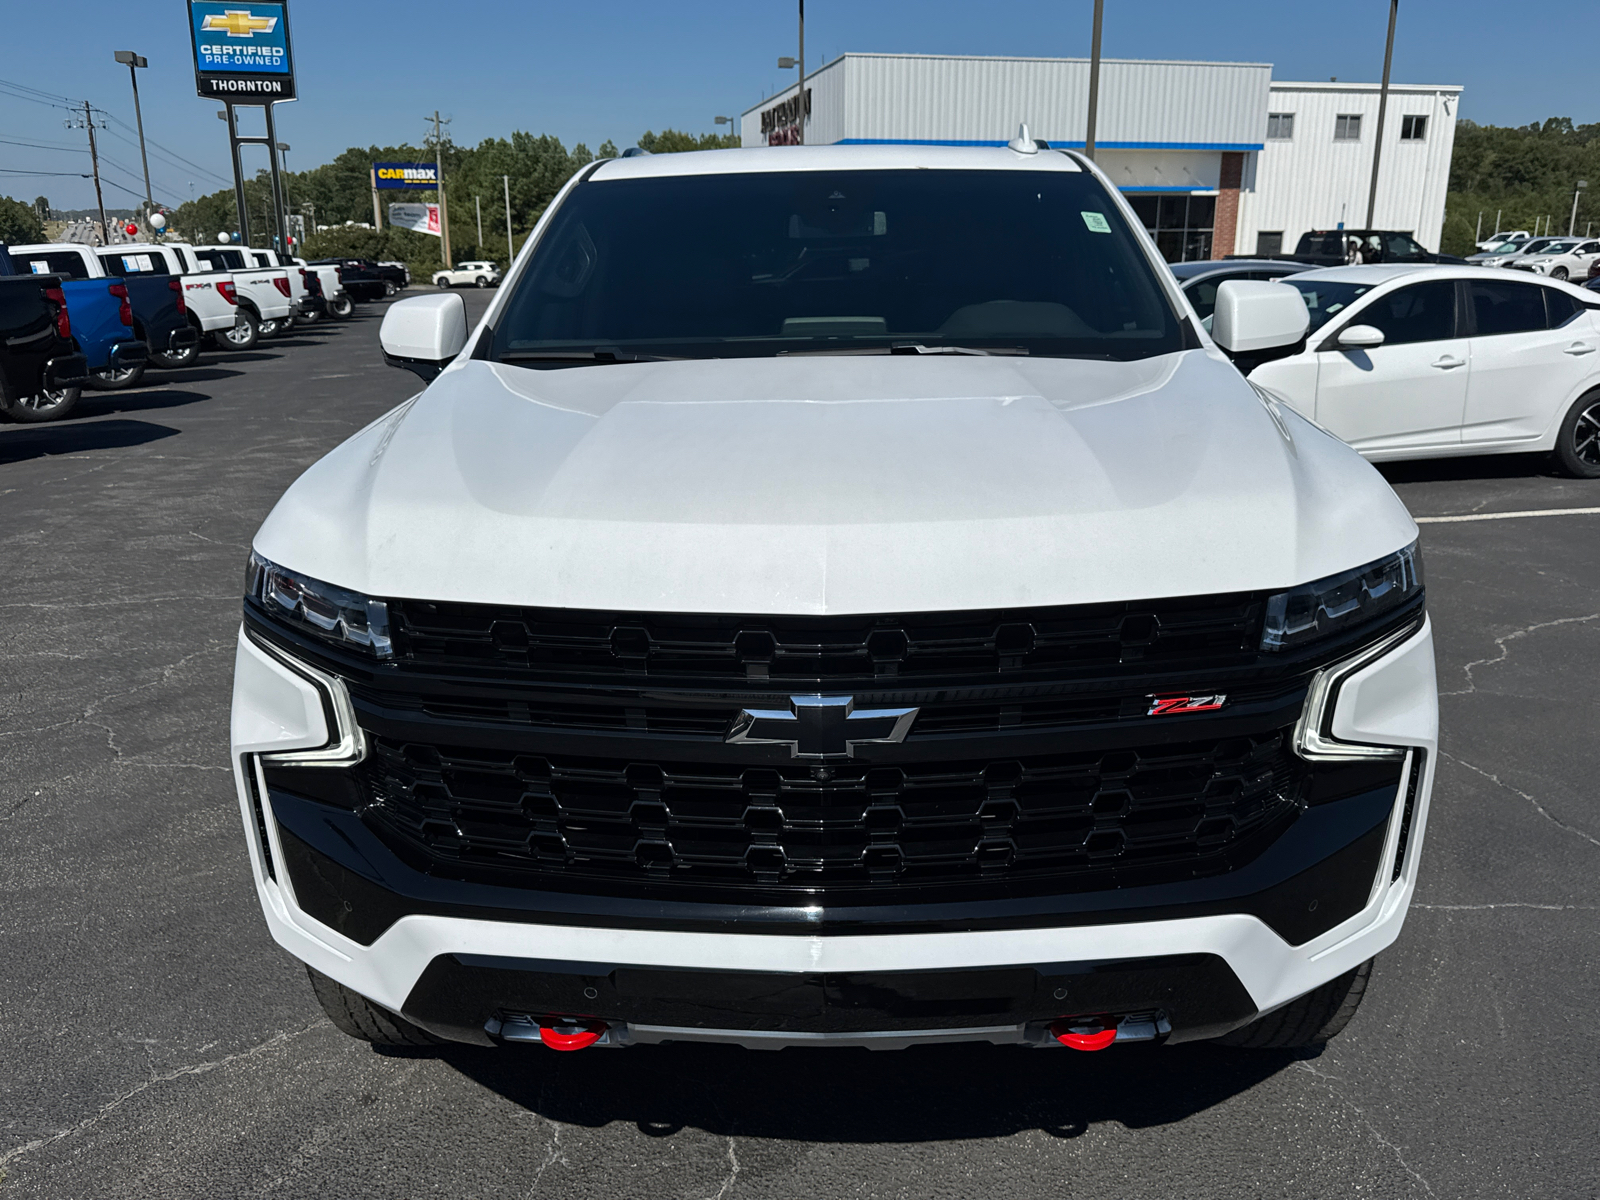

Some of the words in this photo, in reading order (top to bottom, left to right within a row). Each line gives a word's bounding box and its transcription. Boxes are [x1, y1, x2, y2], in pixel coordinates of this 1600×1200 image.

[200, 45, 284, 56] CERTIFIED
[205, 55, 281, 65] PRE-OWNED
[210, 80, 282, 92] THORNTON
